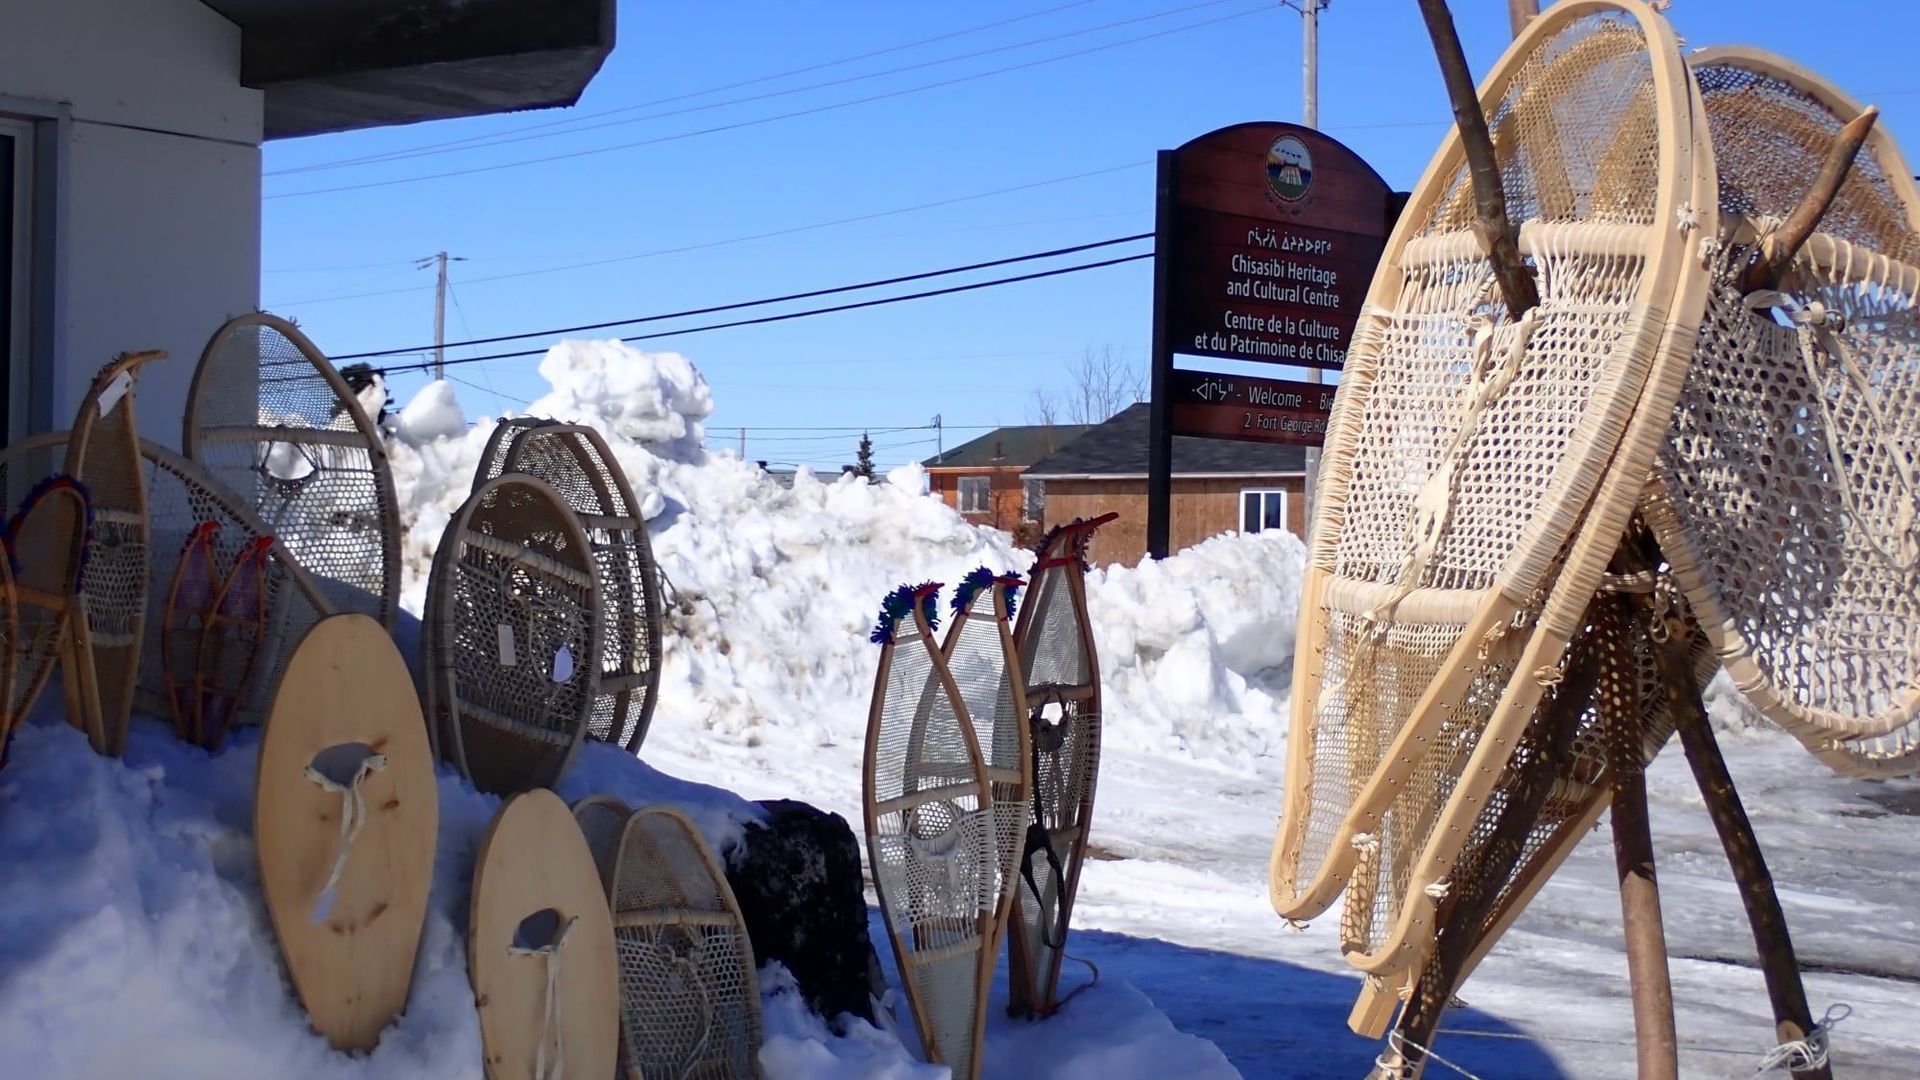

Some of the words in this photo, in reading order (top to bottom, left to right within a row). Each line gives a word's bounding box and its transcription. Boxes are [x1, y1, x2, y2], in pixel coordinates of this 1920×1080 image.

[1231, 254, 1285, 278] Chisasibi
[1288, 262, 1337, 288] Heritage
[1226, 278, 1250, 297] and
[1253, 280, 1300, 303] Cultural
[1302, 286, 1340, 309] Centre
[1224, 310, 1265, 332] Centre
[1267, 314, 1282, 334] de
[1285, 316, 1295, 335] la
[1299, 318, 1340, 340] Culture
[1194, 332, 1208, 350] et
[1210, 331, 1227, 351] du
[1230, 334, 1297, 359] Patrimoine
[1299, 341, 1313, 360] de
[1248, 386, 1302, 408] Welcome
[1244, 412, 1251, 428] 2
[1256, 413, 1278, 431] Fort
[1280, 415, 1312, 437] George
